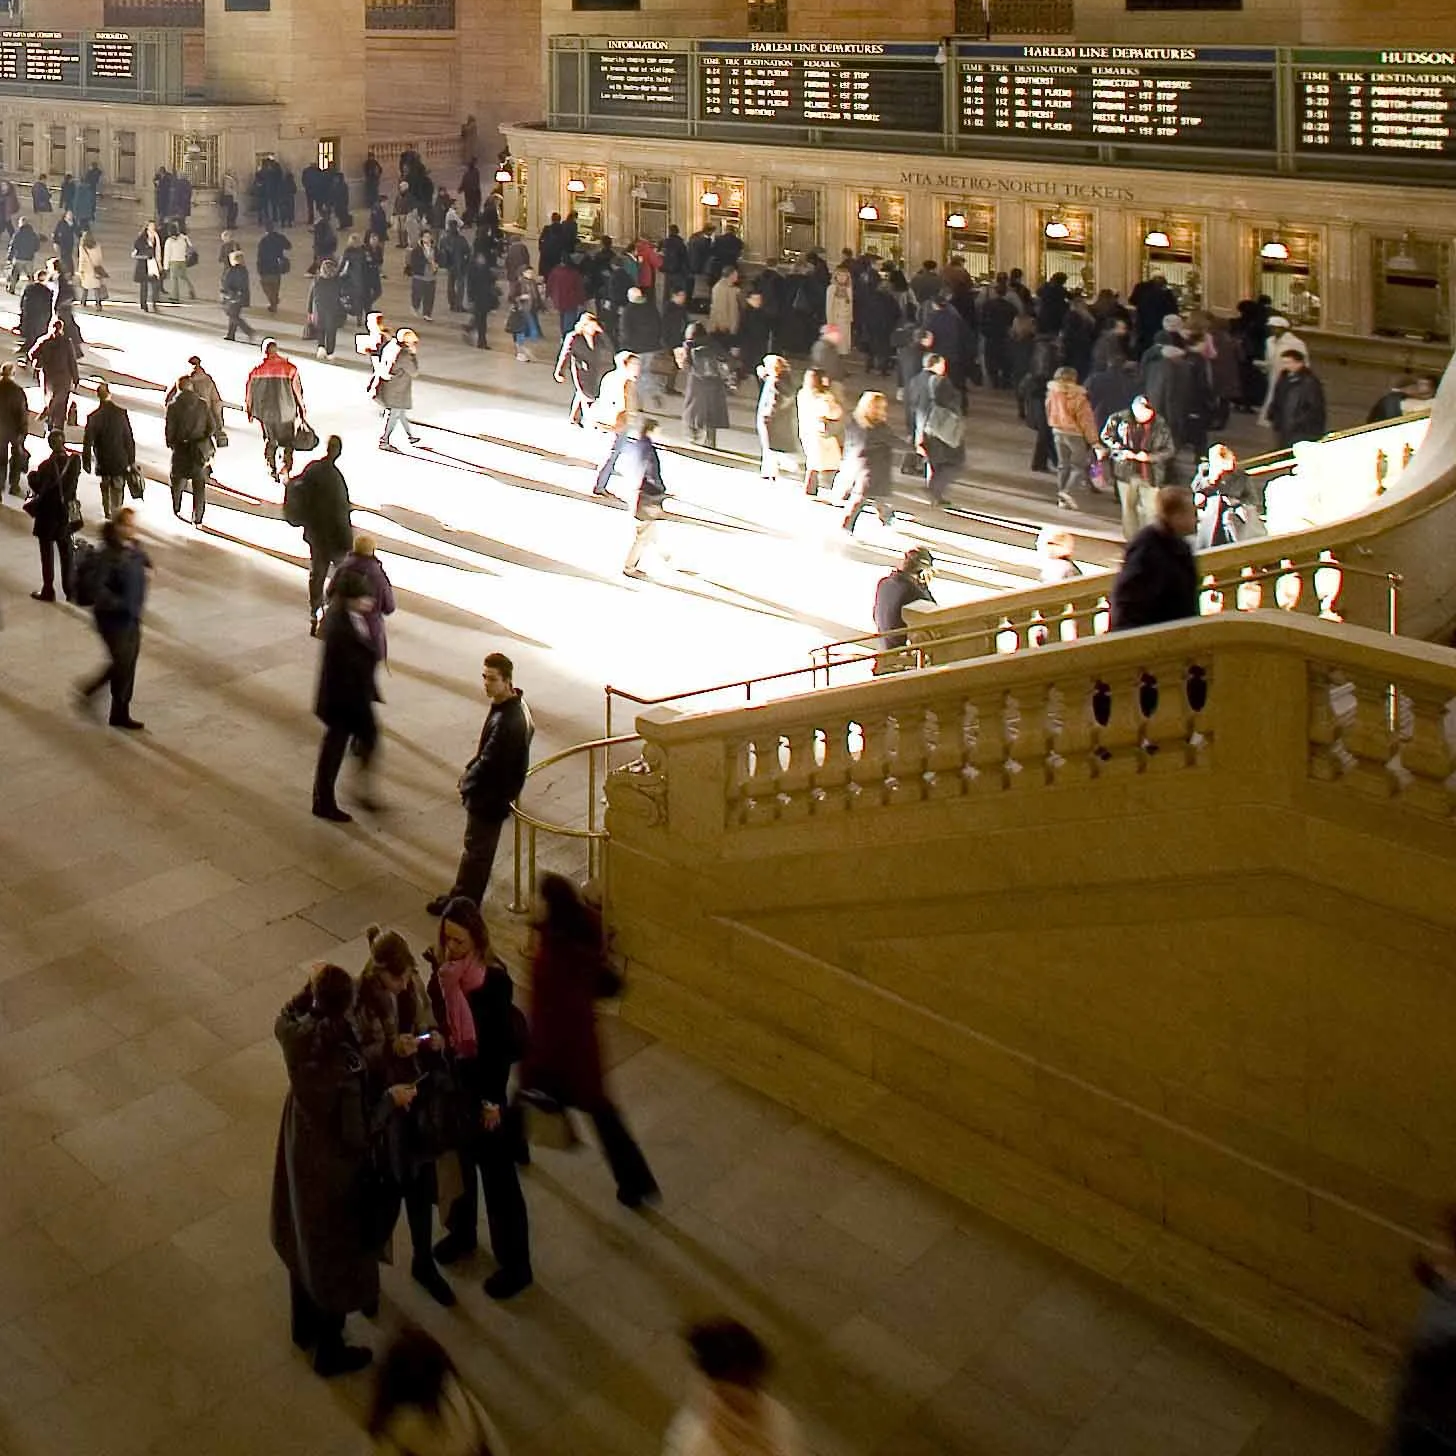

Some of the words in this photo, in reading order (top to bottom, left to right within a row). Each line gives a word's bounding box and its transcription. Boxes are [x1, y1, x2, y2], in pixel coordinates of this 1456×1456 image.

[608, 40, 669, 50] INFORMATION
[751, 43, 792, 52] HARLEM
[795, 43, 817, 52] LINE
[819, 44, 884, 54] DEPARTURES
[1024, 46, 1076, 57] HARLEM
[1080, 47, 1110, 57] LINE
[1112, 48, 1197, 59] DEPARTURES
[1381, 51, 1456, 64] HUDSON
[962, 63, 984, 71] TIME
[990, 64, 1010, 72] TRK
[1014, 65, 1079, 74] DESTINATION
[1091, 67, 1140, 75] REMARKS
[1302, 71, 1329, 81] TIME
[1338, 72, 1365, 81] TRK
[1371, 73, 1456, 84] DESTINATION
[899, 171, 933, 186] MTA
[935, 174, 1058, 195] METRO-NORTH
[1064, 183, 1136, 201] TICKETS
